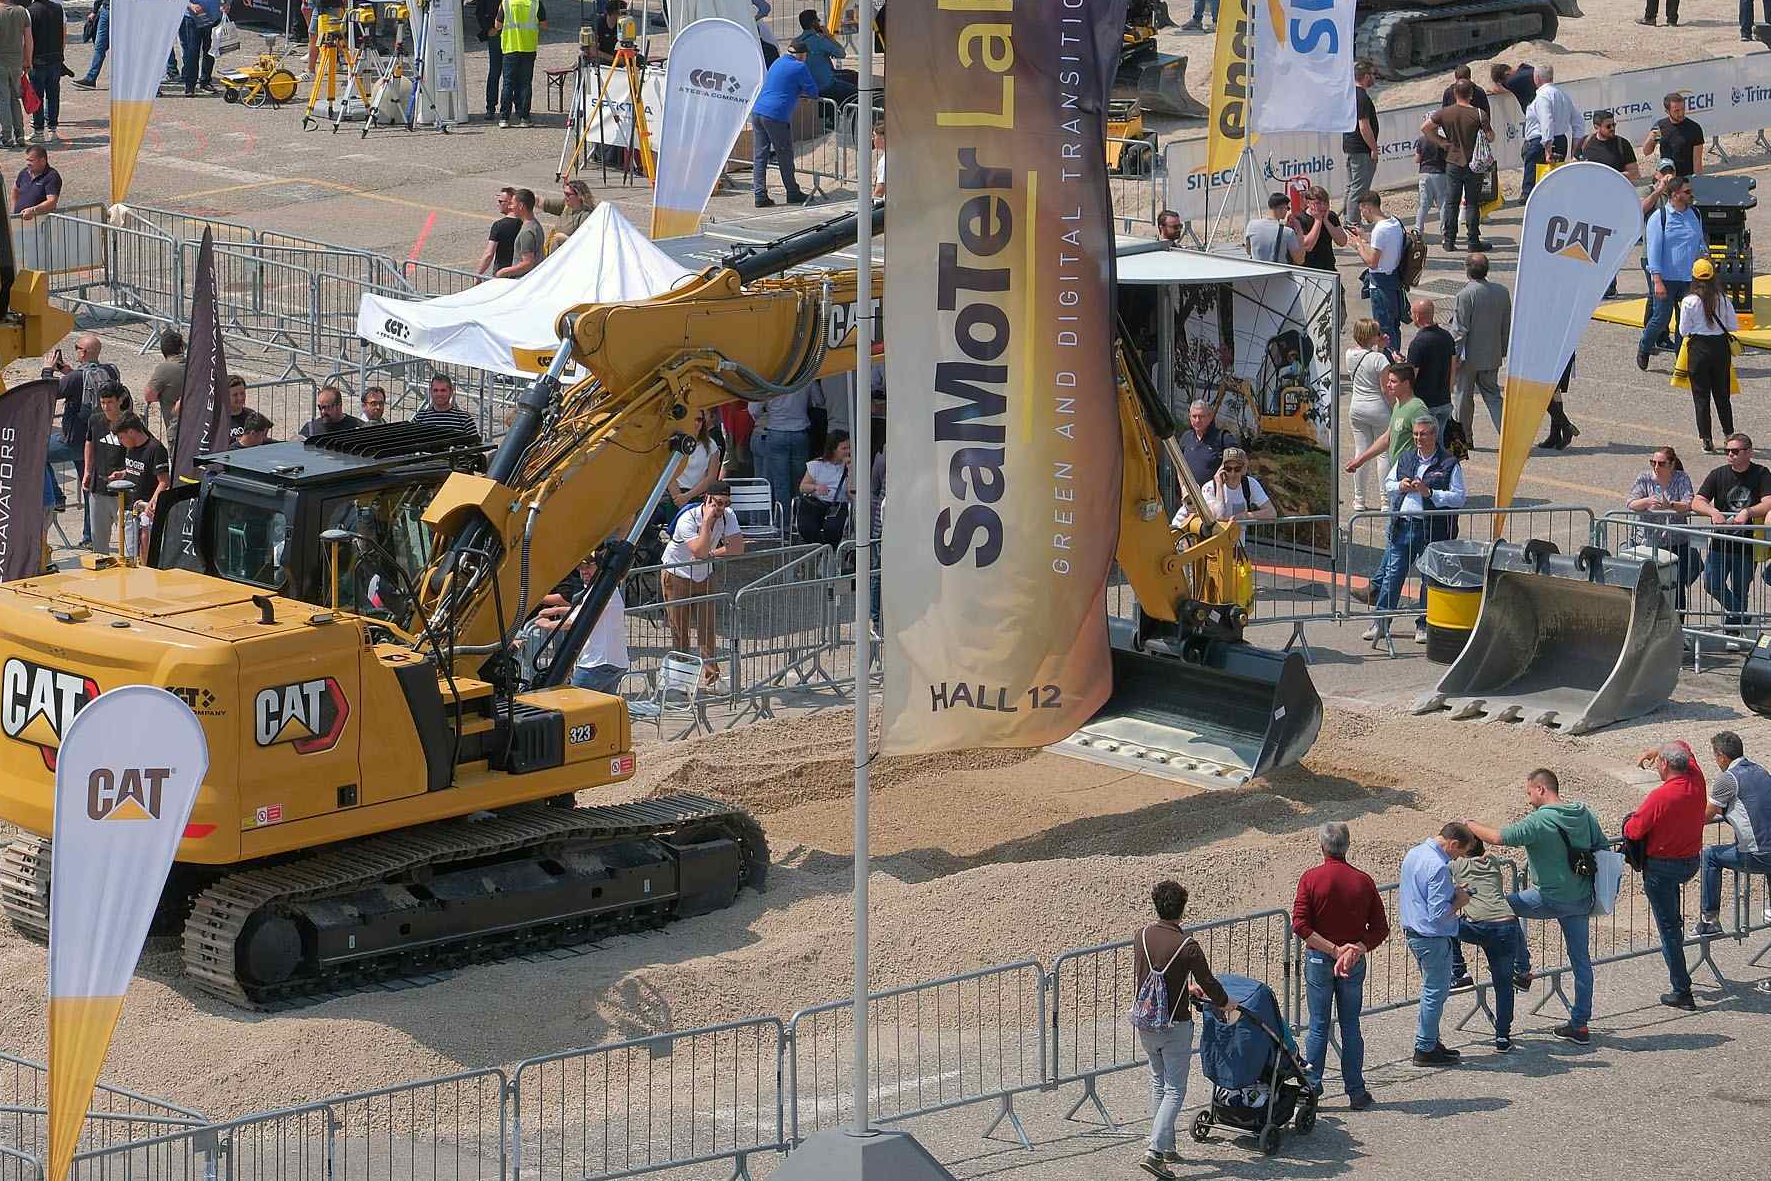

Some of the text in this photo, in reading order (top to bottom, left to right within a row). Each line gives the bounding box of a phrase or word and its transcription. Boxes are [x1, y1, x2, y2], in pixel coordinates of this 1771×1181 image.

[689, 68, 727, 91] CGT
[1279, 154, 1335, 179] Trimble
[1545, 216, 1612, 264] CAT
[1057, 206, 1082, 347] DIGITAL
[933, 146, 1013, 569] SaMoTer
[1054, 370, 1077, 439] AND
[1051, 462, 1075, 575] GREEN
[3, 658, 85, 737] CAT
[255, 679, 326, 746] CAT
[930, 682, 1062, 713] HALL 12
[570, 724, 591, 742] 323
[87, 768, 170, 820] CAT
